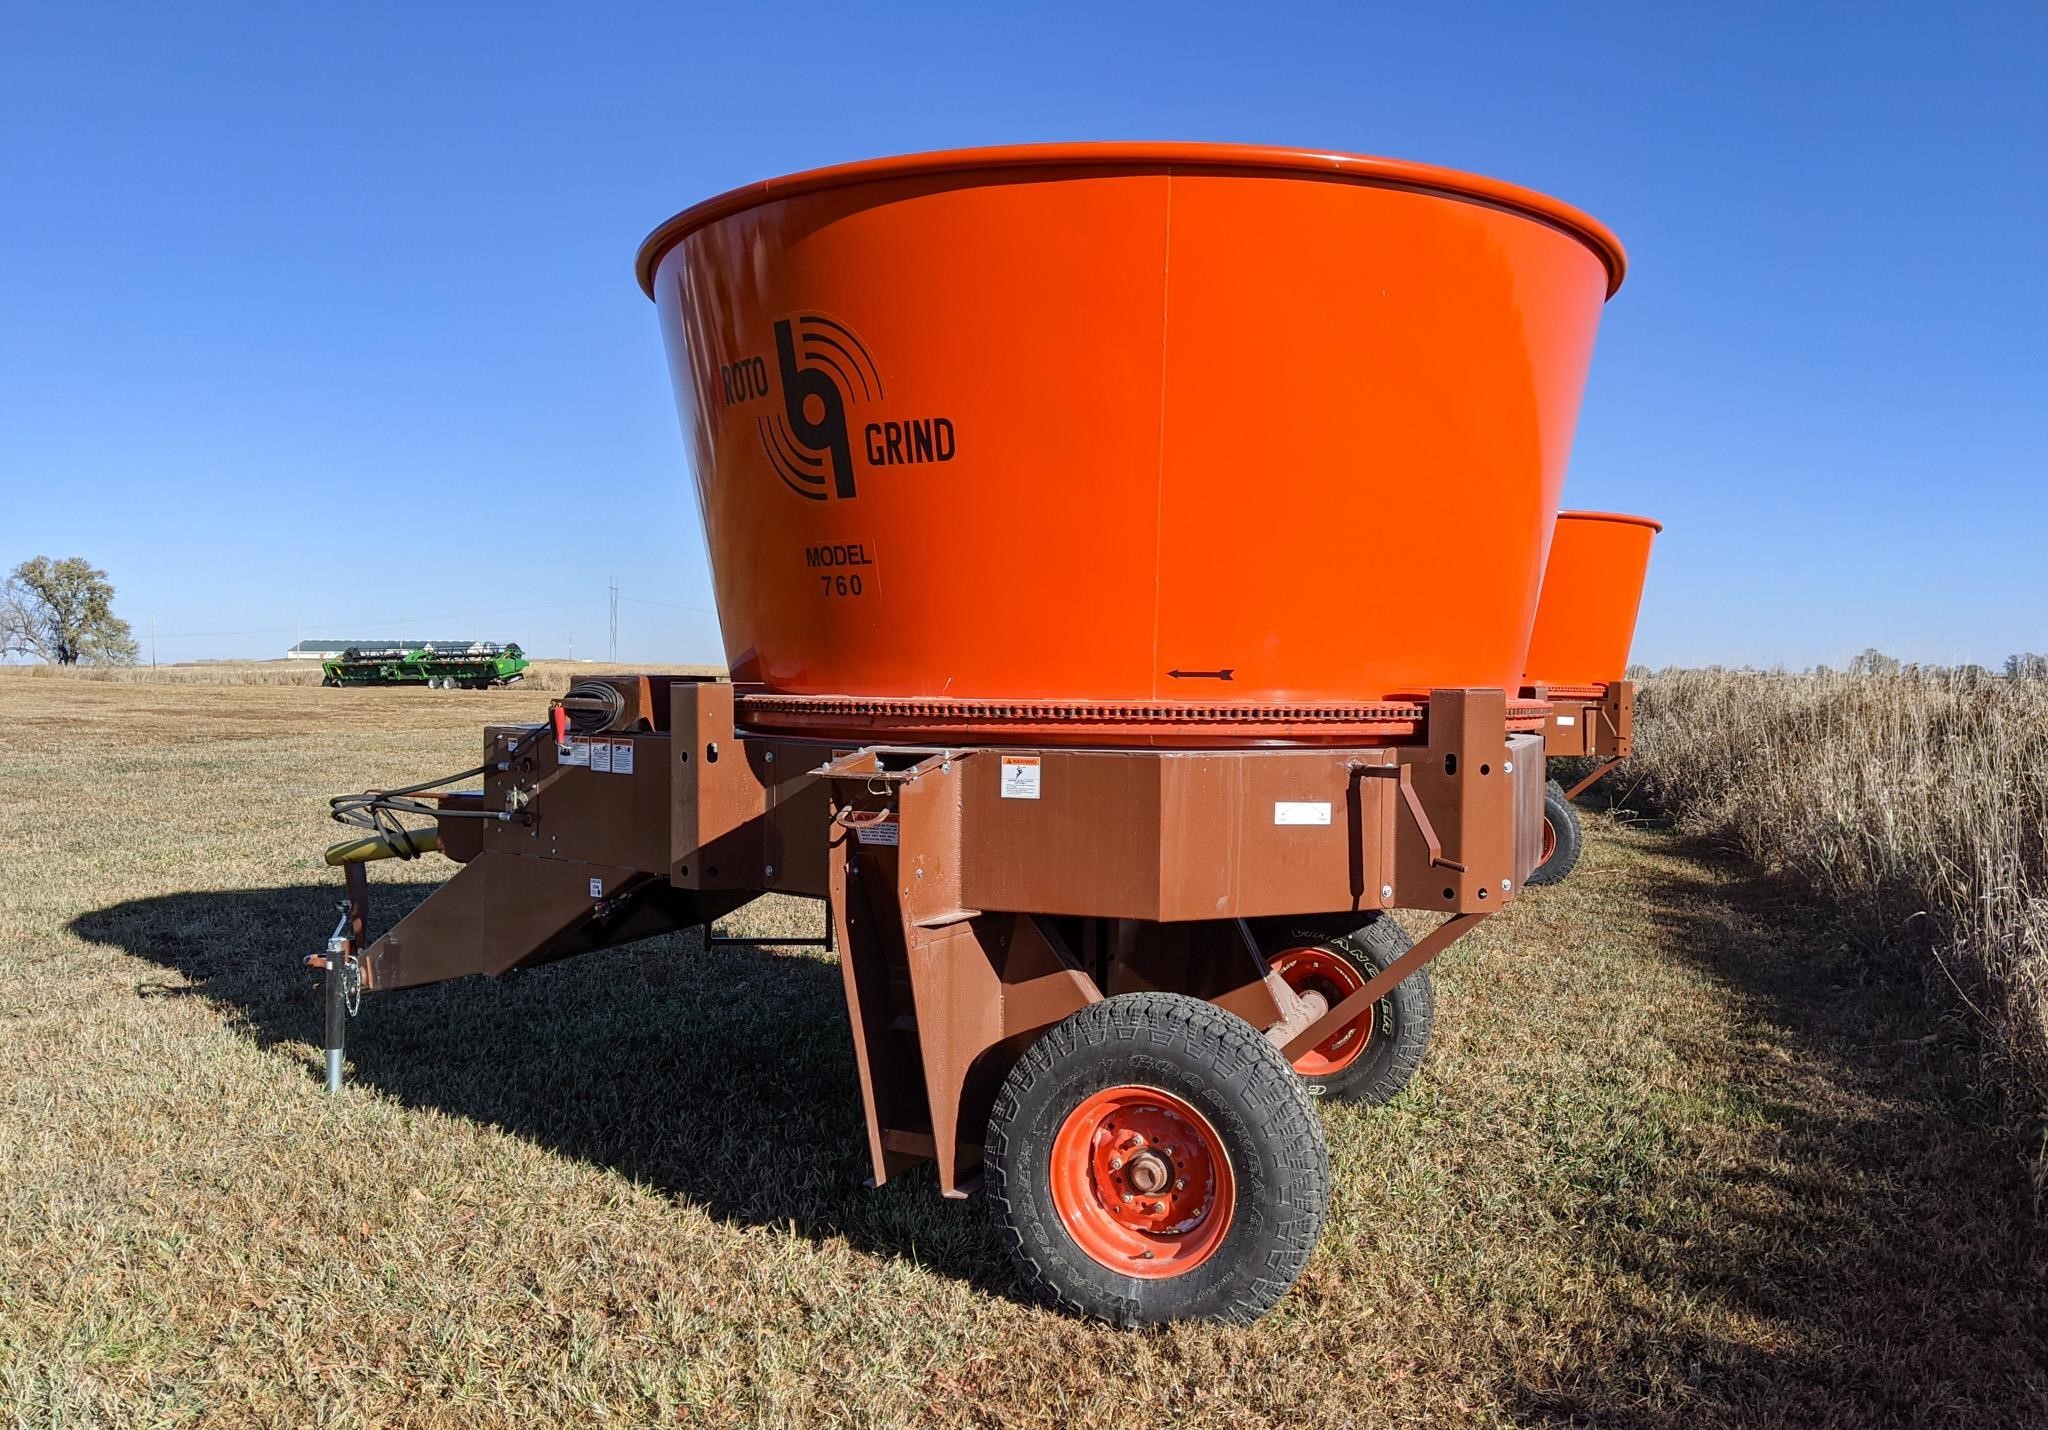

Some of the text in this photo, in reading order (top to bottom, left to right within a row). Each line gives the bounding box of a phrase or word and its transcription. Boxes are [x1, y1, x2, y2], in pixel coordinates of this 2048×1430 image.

[721, 356, 768, 406] ROTO
[865, 418, 955, 466] GRIND
[806, 544, 873, 568] MODEL
[821, 574, 862, 597] 760
[1289, 928, 1393, 1035] WRANGER
